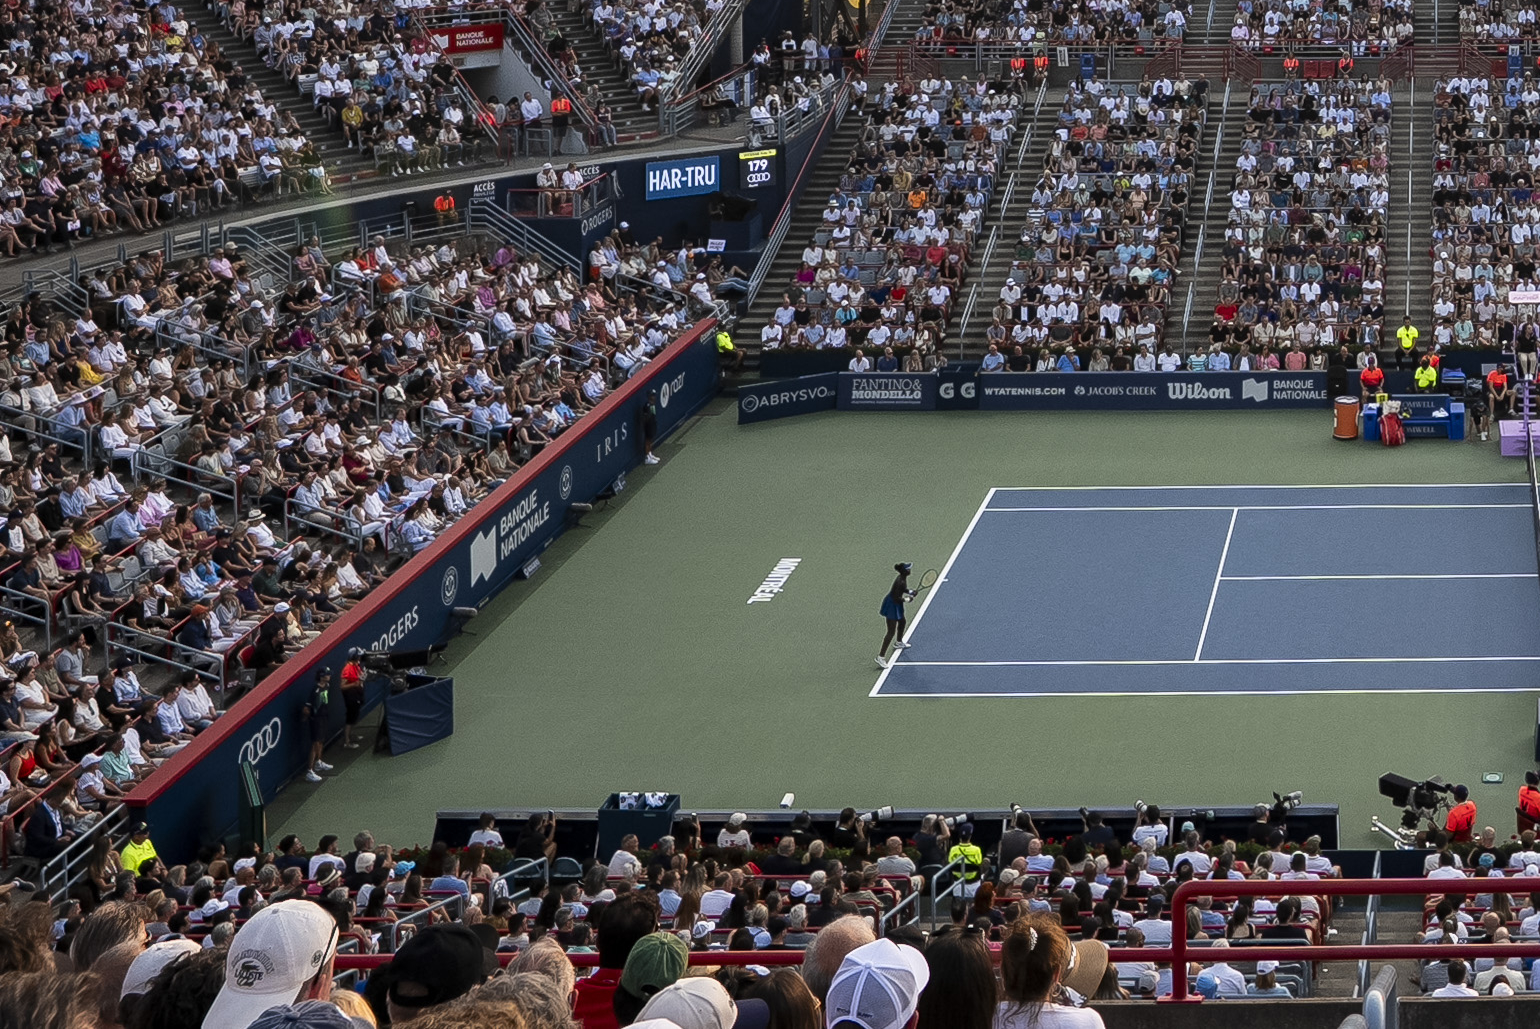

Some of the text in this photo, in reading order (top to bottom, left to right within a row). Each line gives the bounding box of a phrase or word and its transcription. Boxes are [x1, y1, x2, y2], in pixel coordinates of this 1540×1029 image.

[747, 159, 768, 172] 179
[649, 164, 716, 192] HAR-TRU
[588, 205, 613, 230] ROGERS
[1087, 386, 1157, 396] JACOB'S CREEK
[1167, 382, 1231, 400] Wilson
[1273, 380, 1314, 389] BANQUE
[851, 390, 922, 399] MONDELLO
[984, 387, 1066, 396] WTATENNIS.COM
[1273, 389, 1328, 400] NATIONALE
[500, 489, 538, 537] BANQUE
[500, 501, 550, 561] NATIONALE
